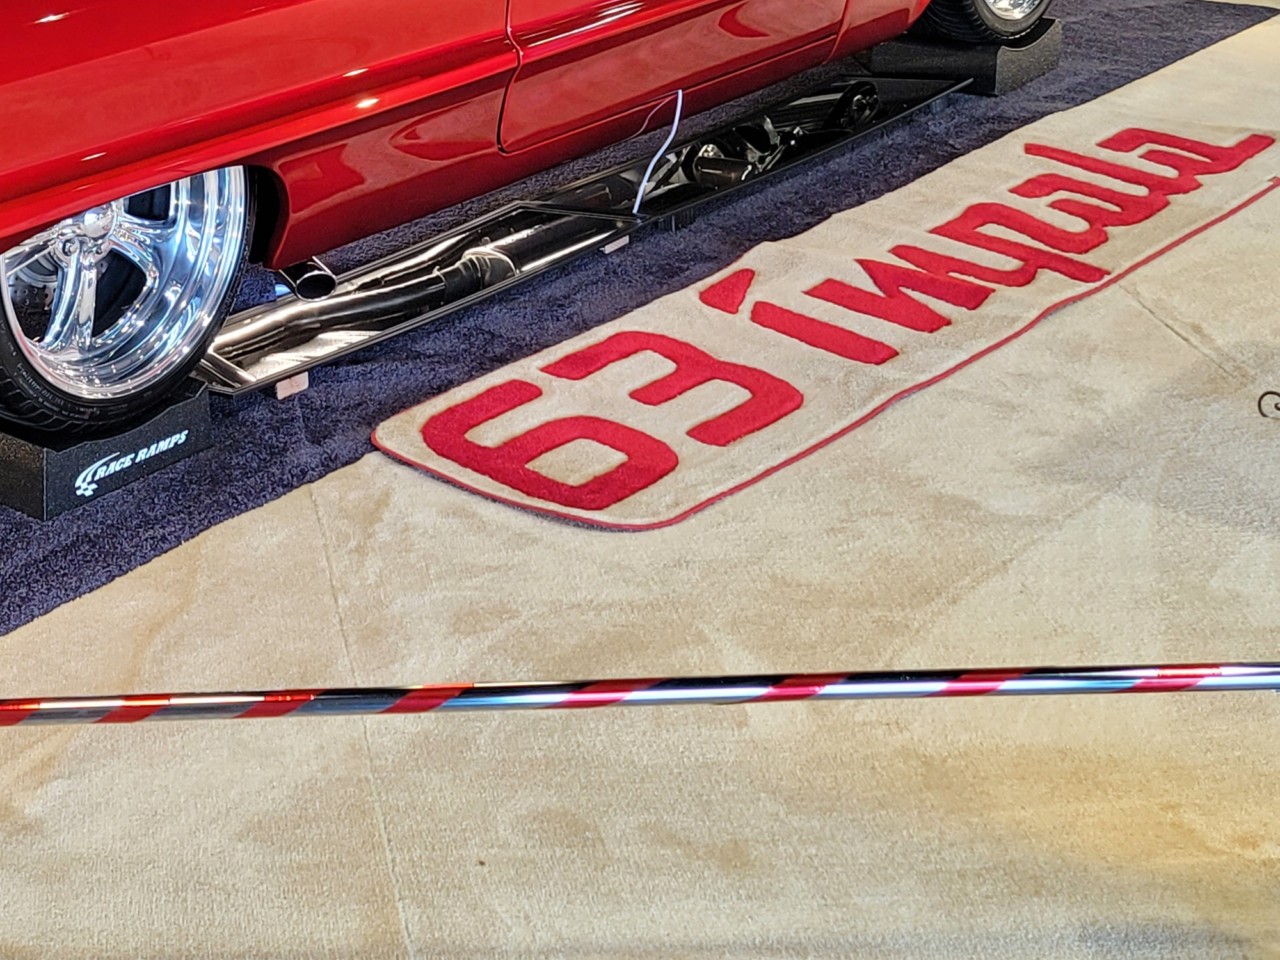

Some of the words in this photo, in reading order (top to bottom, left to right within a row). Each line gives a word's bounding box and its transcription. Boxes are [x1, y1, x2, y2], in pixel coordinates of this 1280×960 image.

[93, 452, 136, 482] RACE
[135, 429, 189, 464] RAMPS
[420, 330, 805, 511] 63
